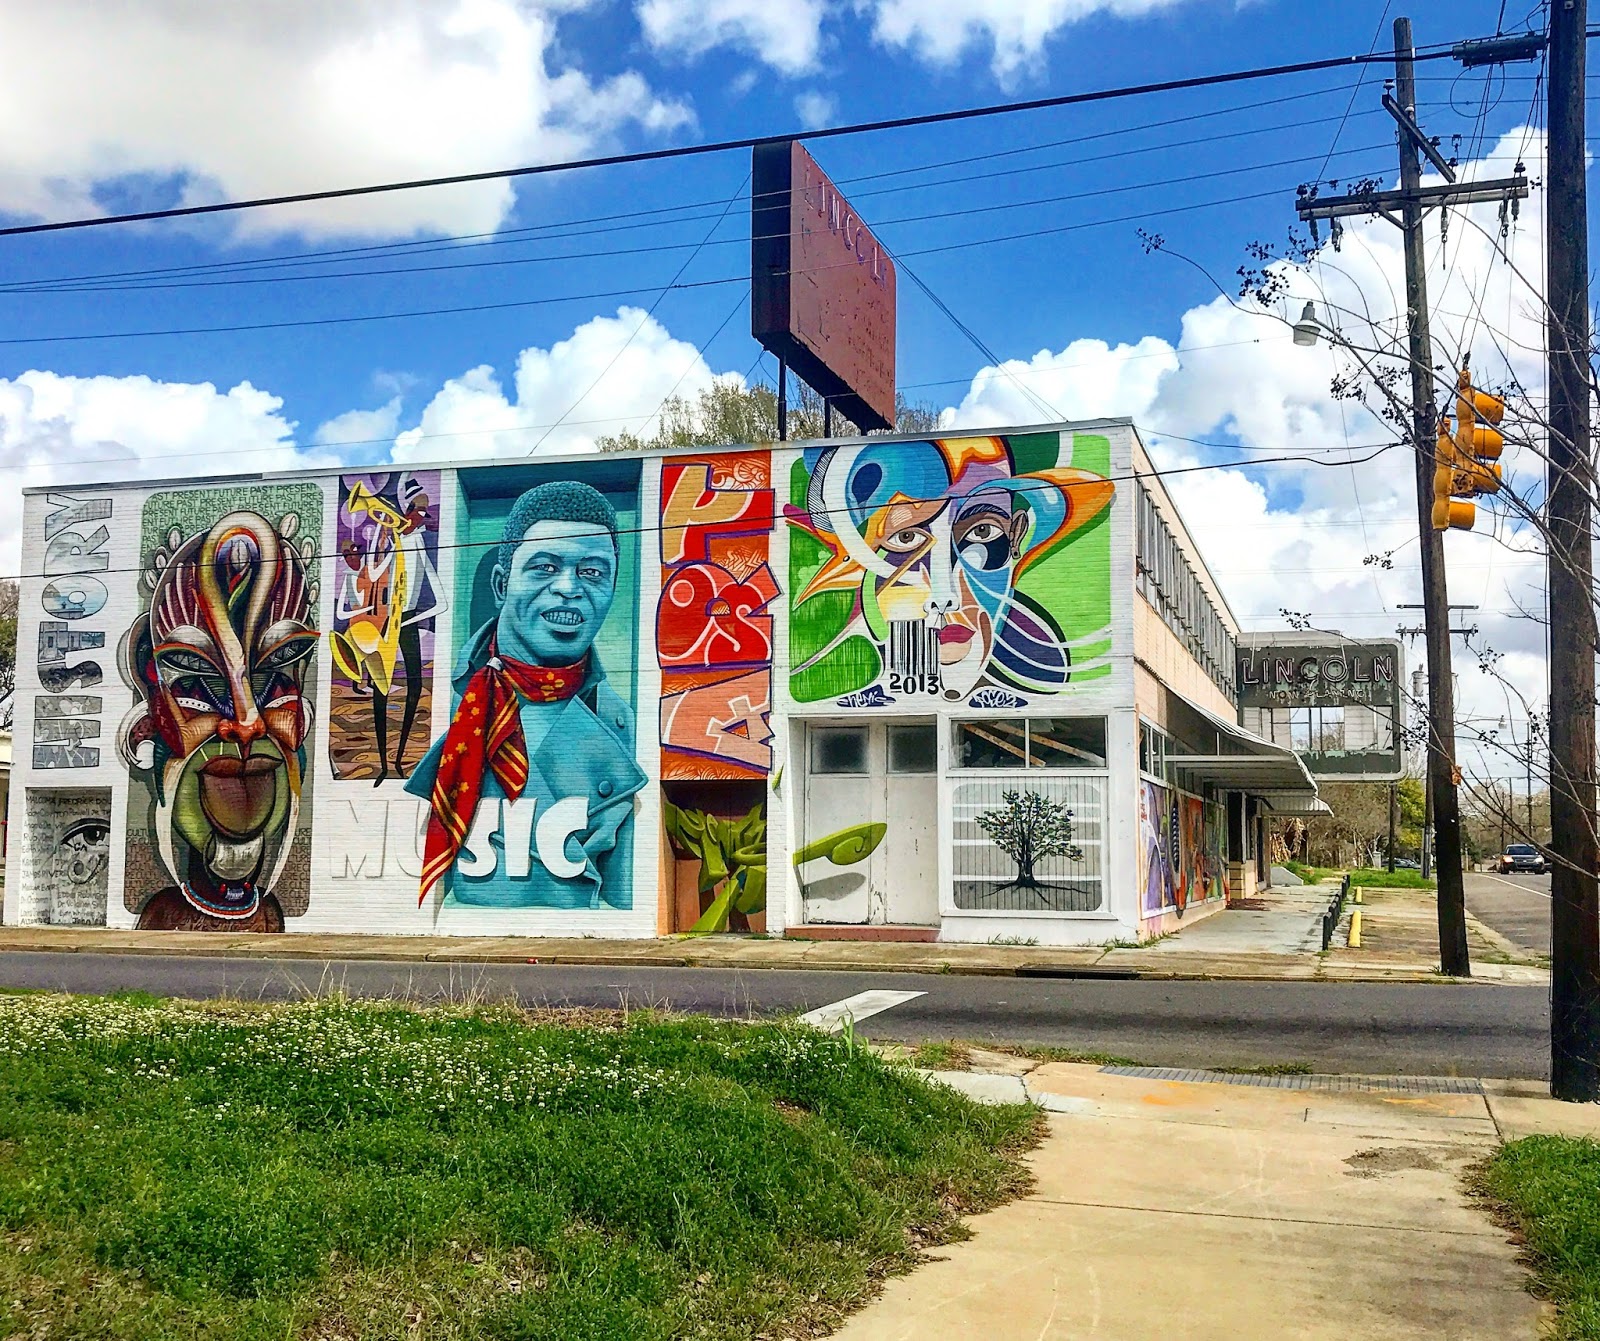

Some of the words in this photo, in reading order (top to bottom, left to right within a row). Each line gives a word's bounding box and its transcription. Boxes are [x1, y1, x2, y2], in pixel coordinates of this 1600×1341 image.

[172, 489, 212, 500] PRESENT
[214, 487, 249, 498] FUTURE
[250, 485, 274, 495] PAST
[276, 483, 317, 494] PRESENT
[176, 498, 198, 508] PAST
[199, 495, 237, 506] PRESENT
[238, 493, 275, 505] FUTURE
[275, 492, 298, 502] PAST
[32, 492, 113, 769] HISTORY
[1241, 655, 1393, 684] LINCOLN
[889, 672, 940, 695] 2013
[328, 796, 590, 880] MUSIC
